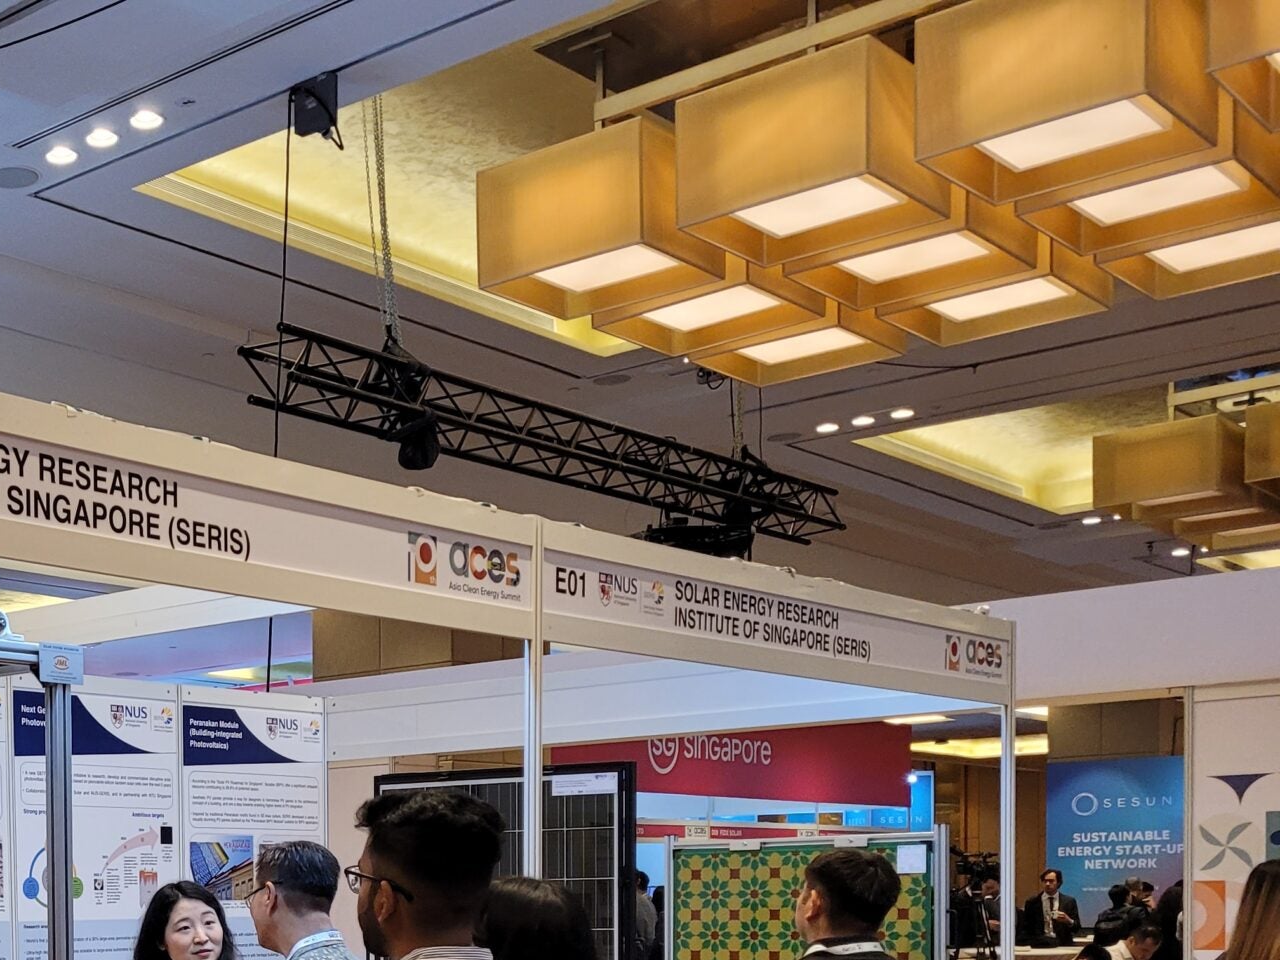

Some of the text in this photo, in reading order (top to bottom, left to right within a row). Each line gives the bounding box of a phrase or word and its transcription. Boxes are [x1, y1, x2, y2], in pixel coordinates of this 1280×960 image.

[39, 453, 178, 508] RESEARCH
[7, 485, 160, 540] SINGAPORE
[168, 516, 250, 562] (SERIS)
[449, 541, 520, 587] aces
[449, 581, 521, 602] Asia Clean Energy Summit
[556, 567, 585, 598] E01
[614, 574, 638, 595] NUS
[675, 580, 839, 630] SOLAR ENERGY RESEARCH
[674, 607, 739, 637] INSTITUTE
[743, 619, 760, 639] OF
[763, 623, 830, 652] SINGAPORE
[833, 635, 871, 662] (SERIS)
[966, 639, 1002, 668] aces
[21, 704, 36, 714] Next
[125, 706, 147, 719] NUS
[279, 719, 298, 731] NUS
[1103, 796, 1172, 808] SESUN
[1073, 830, 1170, 843] SUSTAINABLE
[1058, 843, 1184, 857] ENERGY START-UP
[1084, 858, 1157, 870] NETWORK
